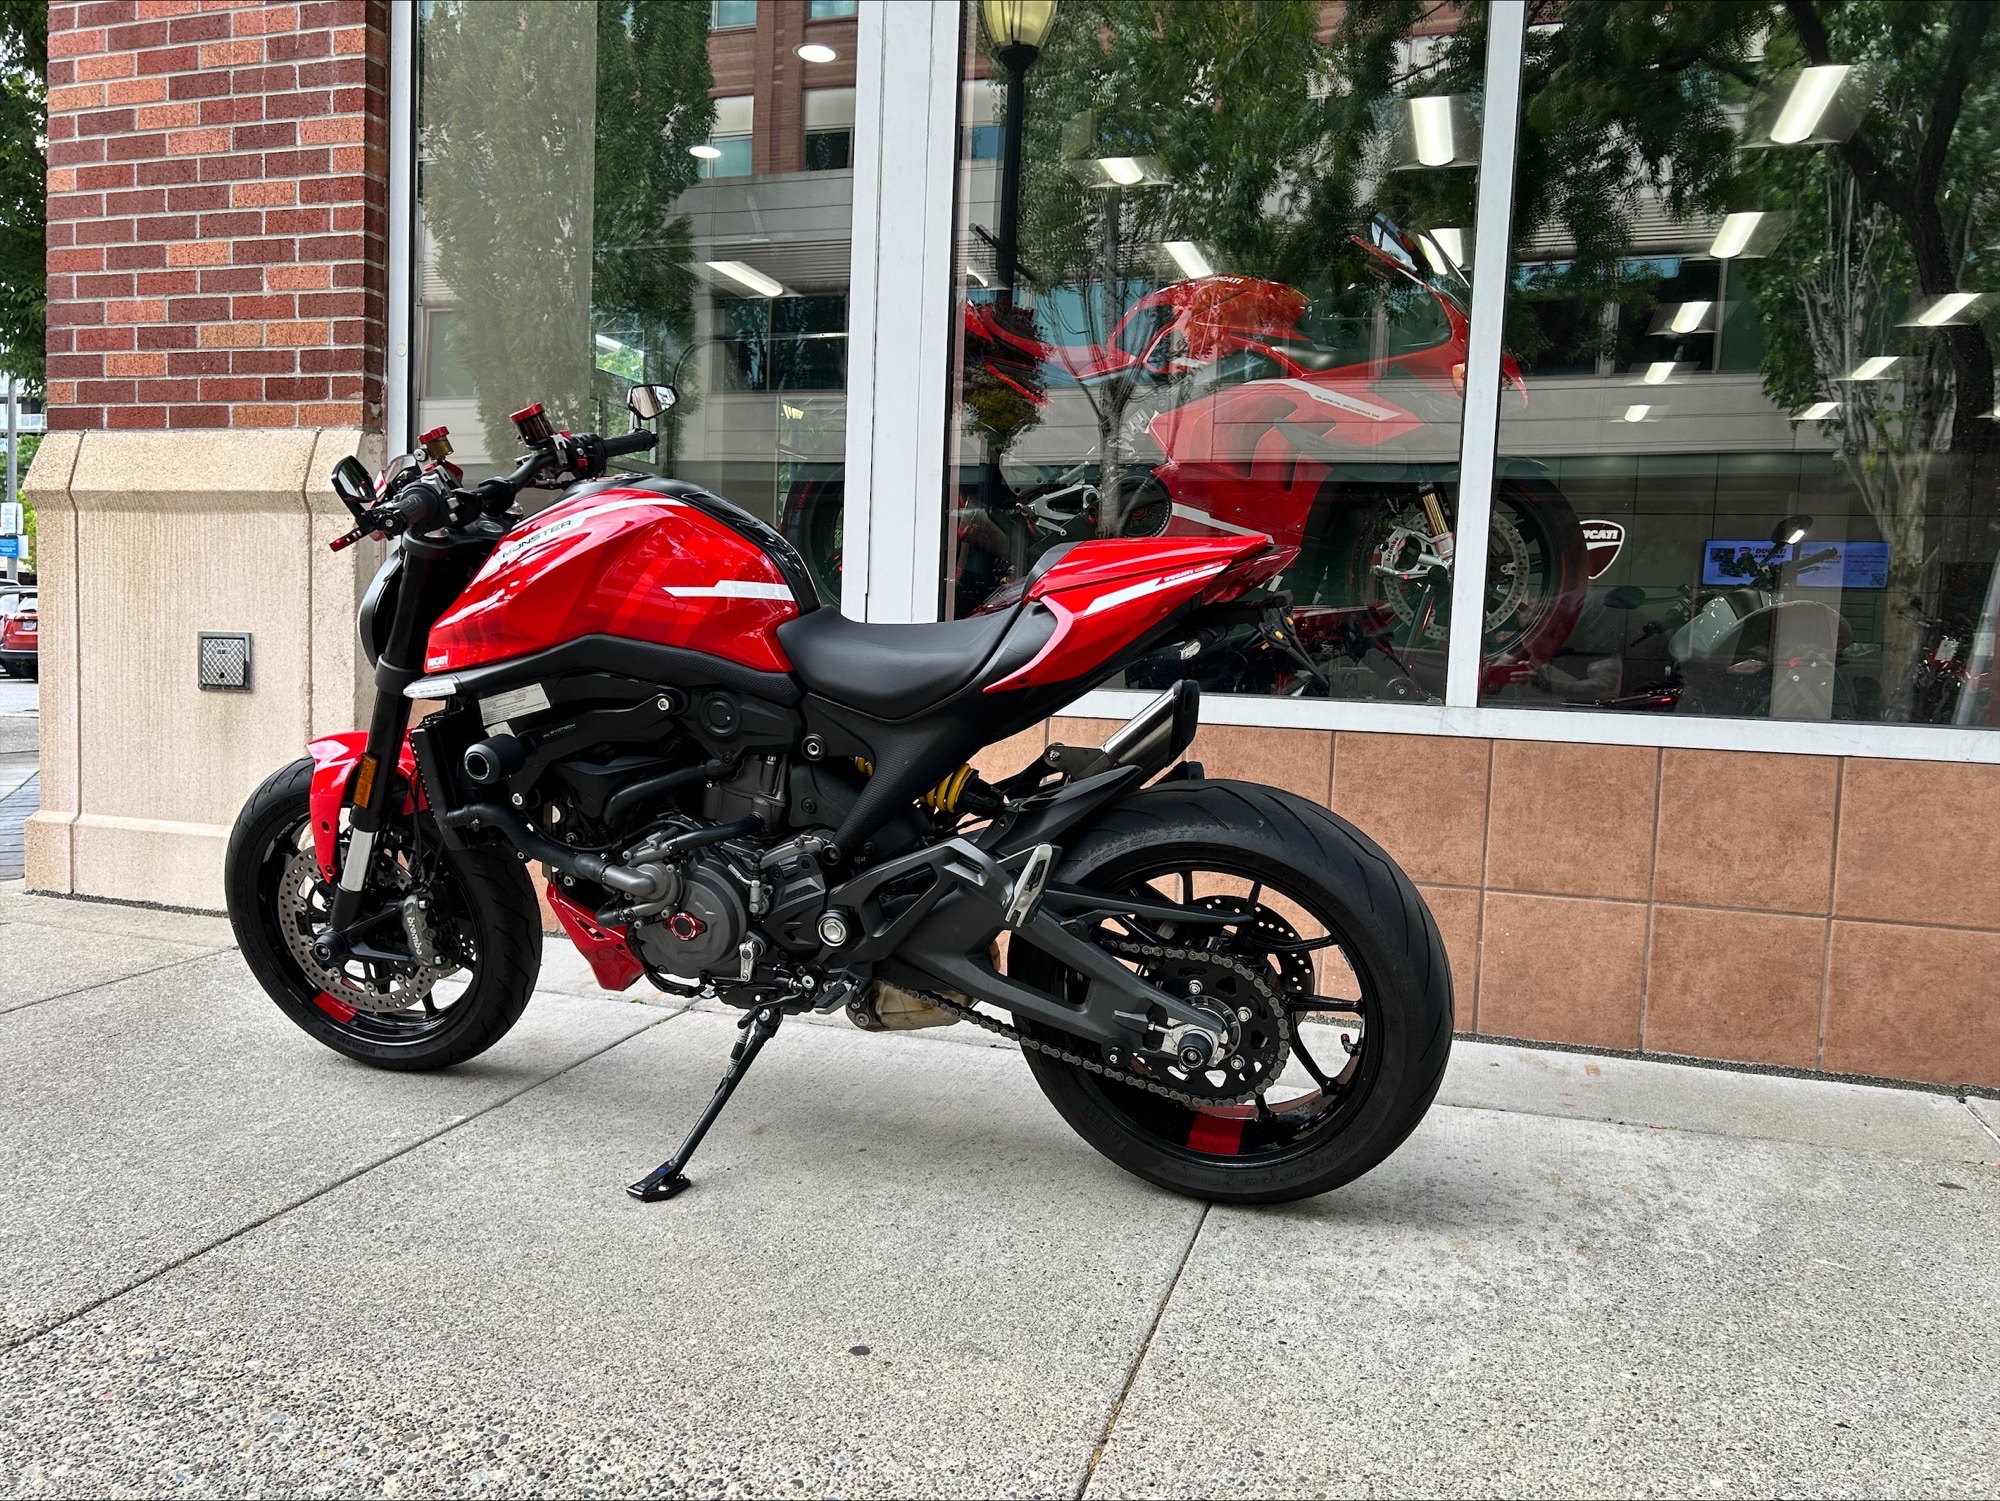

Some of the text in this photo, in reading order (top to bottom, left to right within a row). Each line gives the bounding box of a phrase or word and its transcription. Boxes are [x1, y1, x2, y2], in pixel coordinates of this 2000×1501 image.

[502, 519, 572, 558] MONSTER
[1386, 536, 1399, 562] brembo
[1582, 529, 1618, 540] UCATI
[1163, 568, 1194, 582] DUCATI
[1090, 832, 1159, 868] ROSSO
[406, 916, 423, 955] brembo
